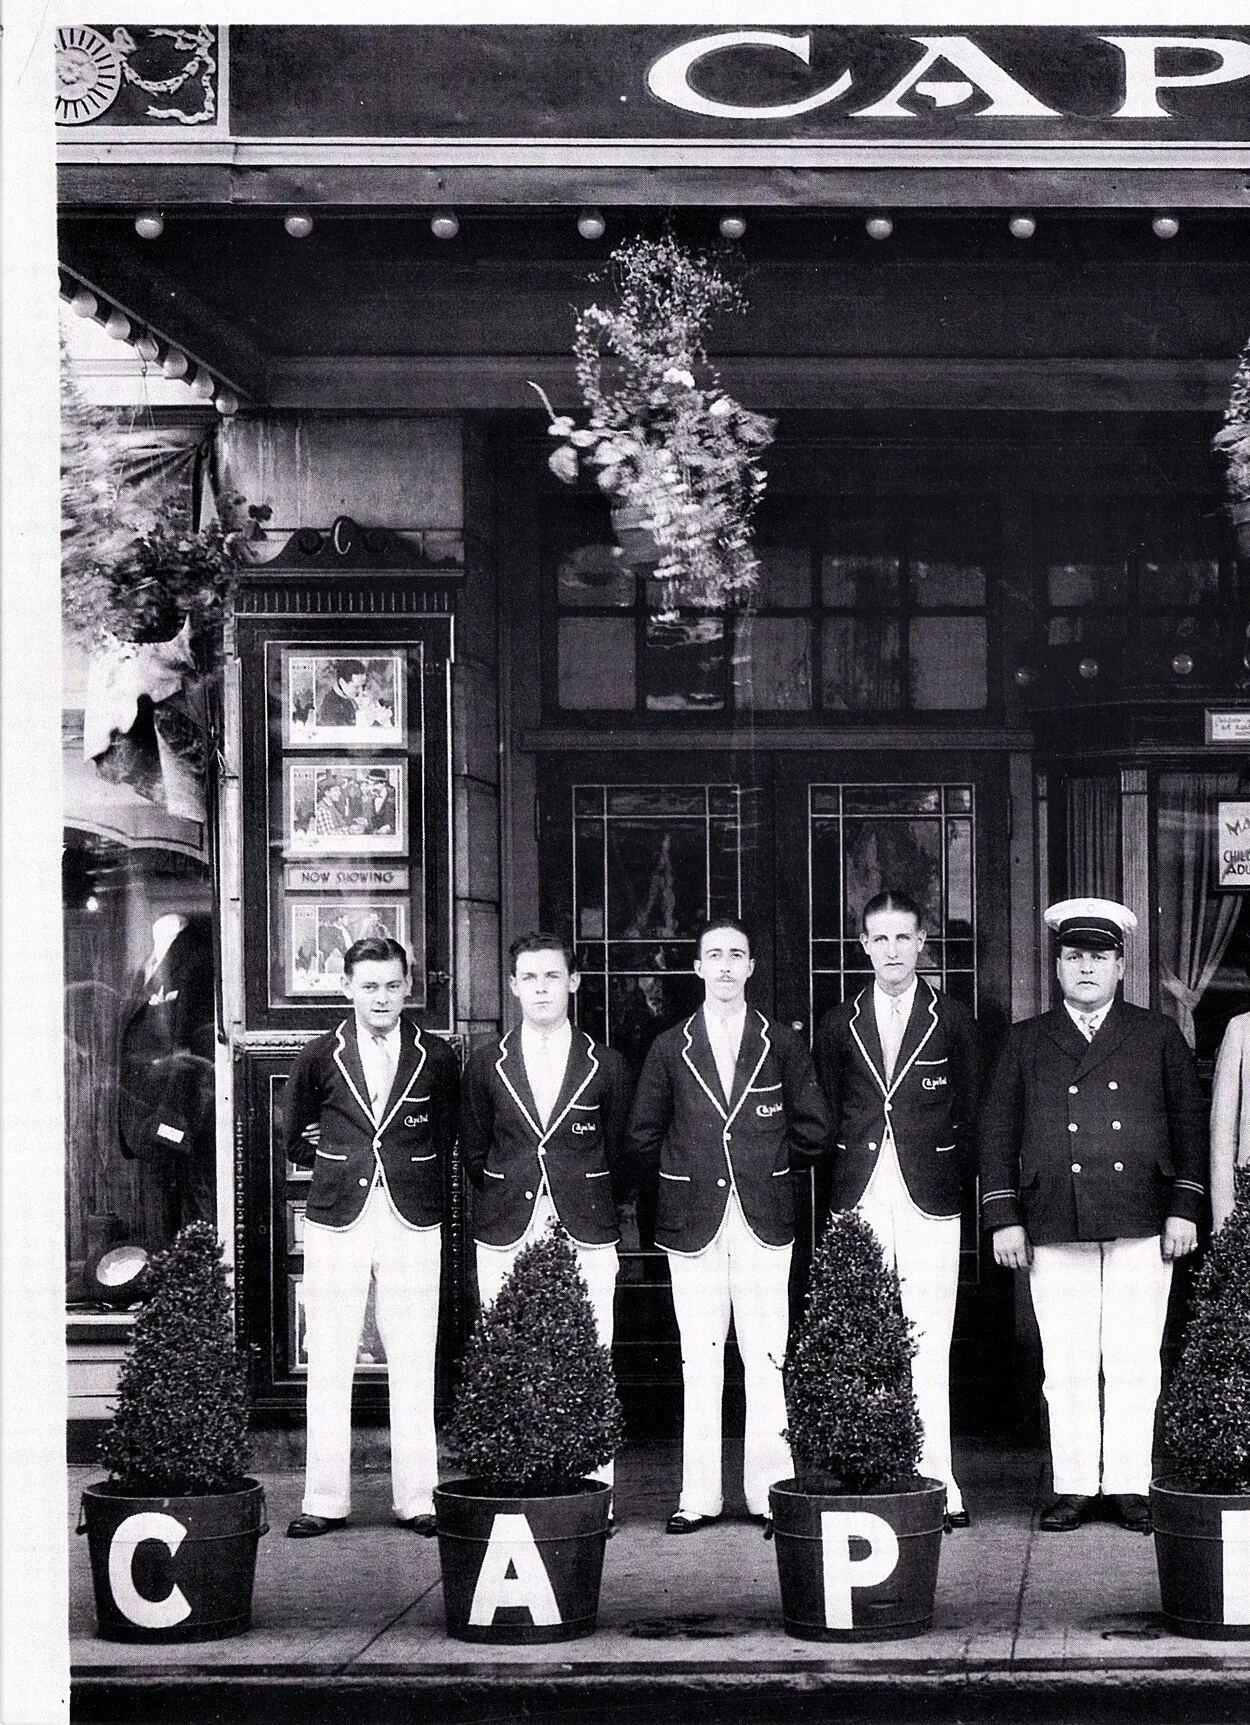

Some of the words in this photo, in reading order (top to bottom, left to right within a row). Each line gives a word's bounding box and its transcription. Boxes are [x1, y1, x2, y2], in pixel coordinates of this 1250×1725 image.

[301, 872, 330, 883] NOW
[337, 871, 394, 883] SHOWING
[108, 1513, 192, 1628] C
[468, 1513, 562, 1626] A
[821, 1511, 900, 1630] P
